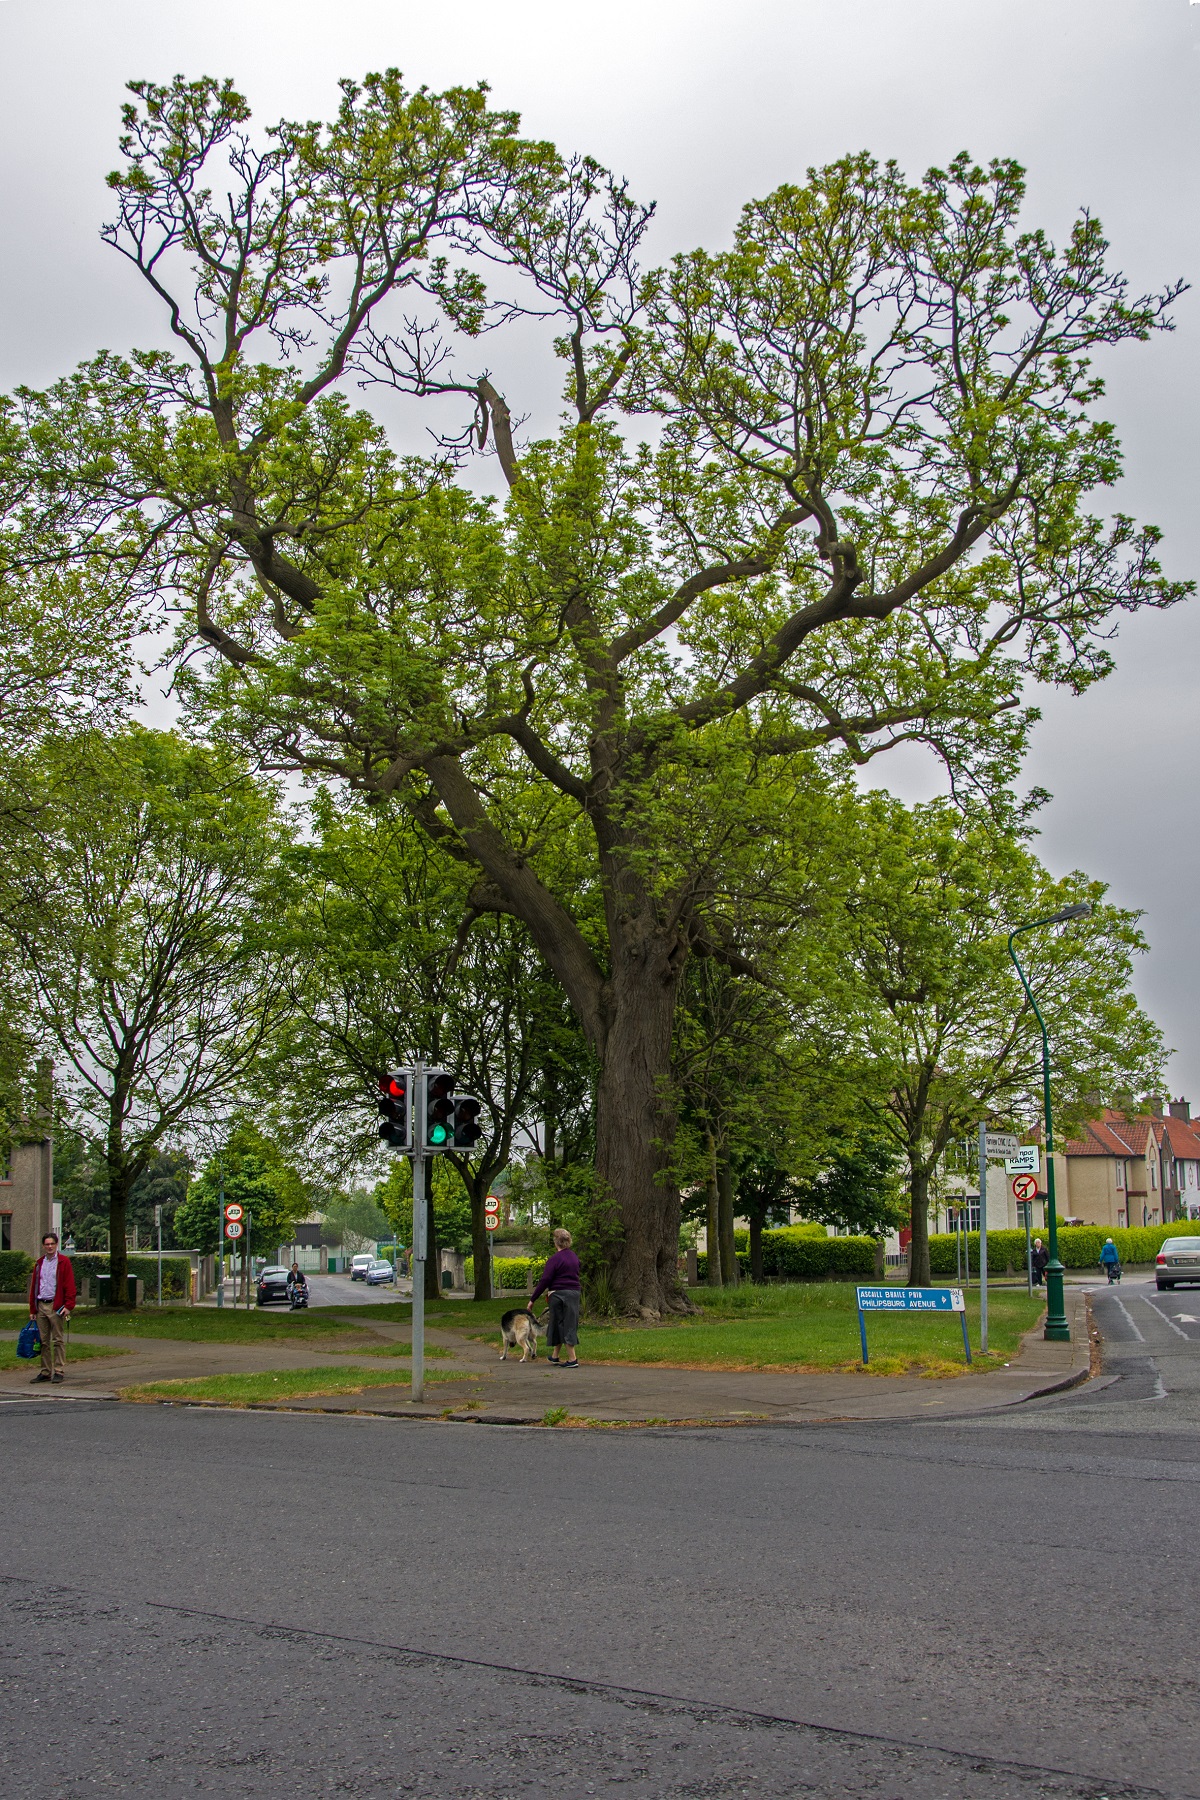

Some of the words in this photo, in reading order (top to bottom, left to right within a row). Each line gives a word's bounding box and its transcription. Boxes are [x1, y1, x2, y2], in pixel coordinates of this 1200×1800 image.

[487, 1216, 495, 1224] 30
[230, 1225, 239, 1233] 30
[861, 1299, 905, 1307] PHILIPSBURG
[909, 1300, 936, 1308] AVENUE
